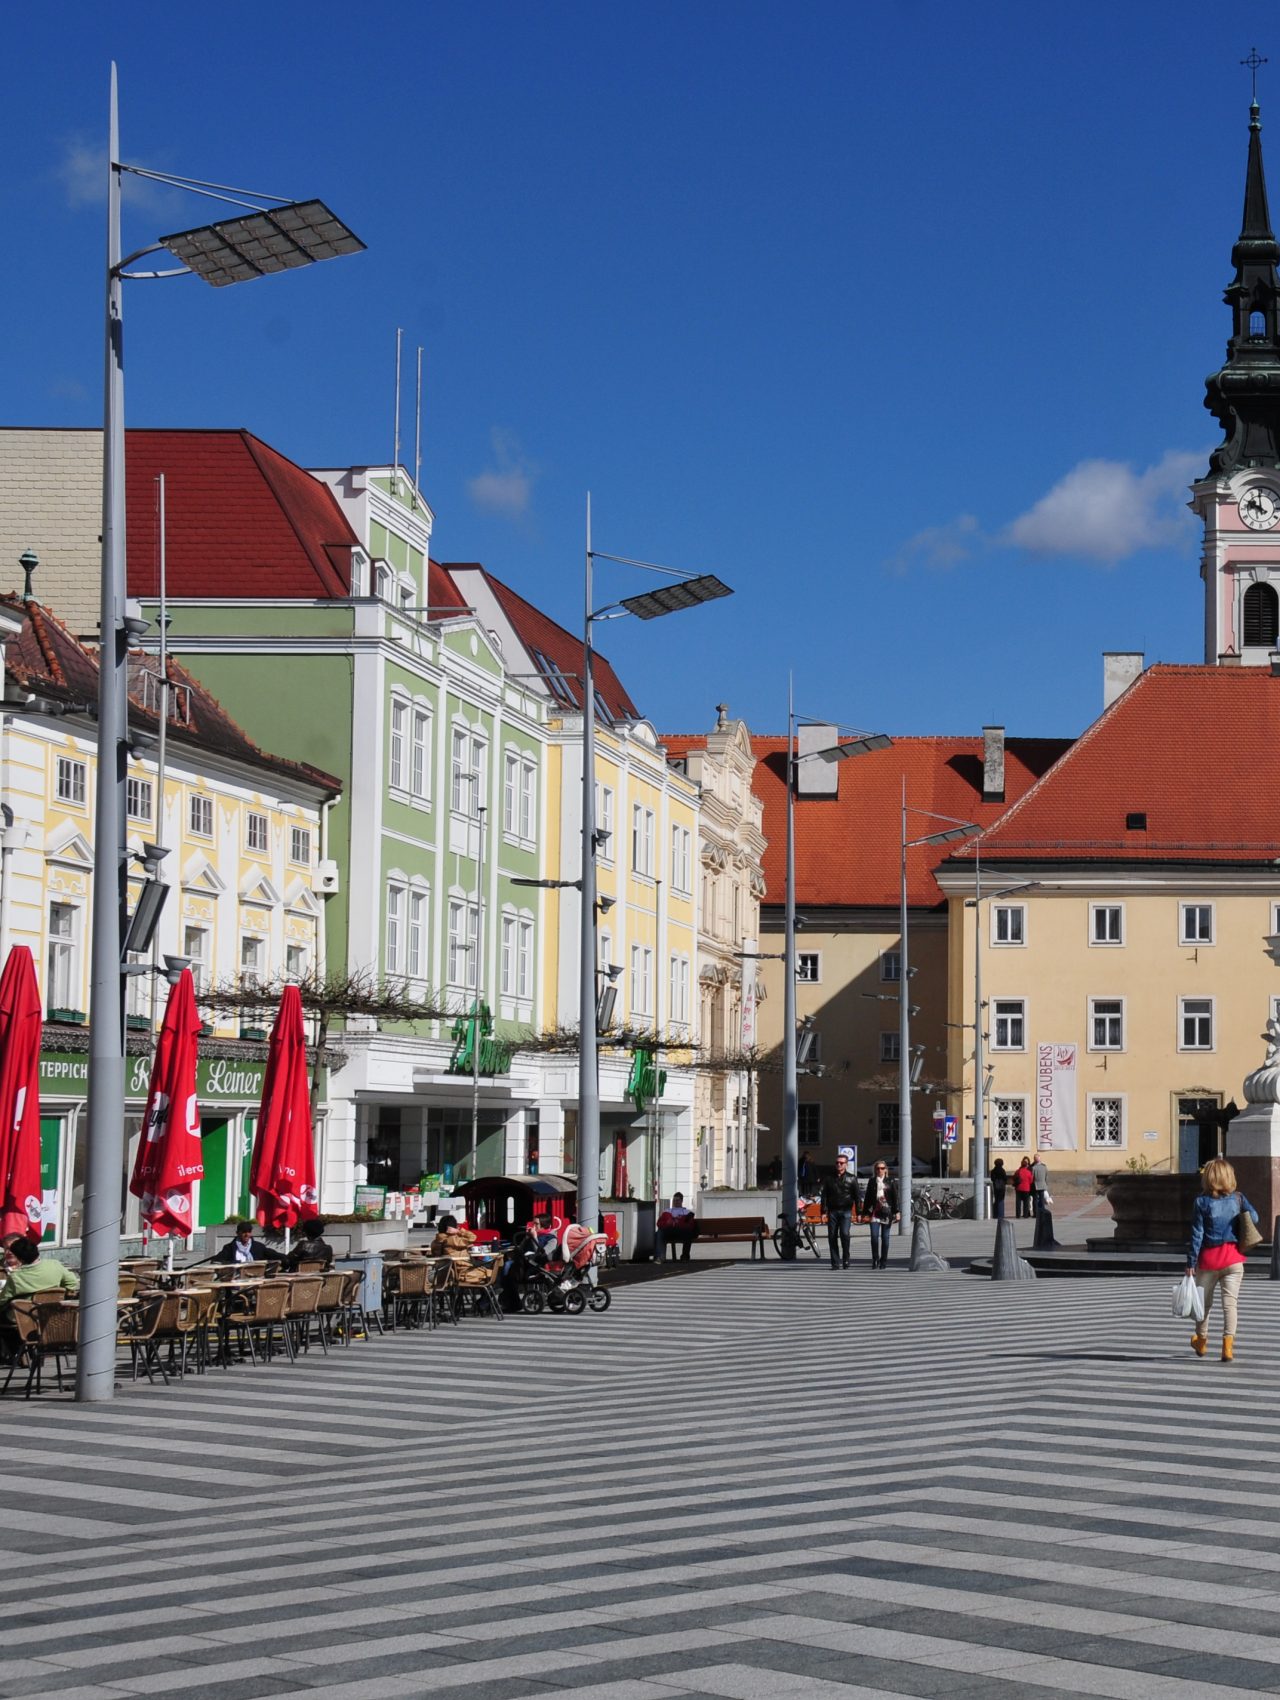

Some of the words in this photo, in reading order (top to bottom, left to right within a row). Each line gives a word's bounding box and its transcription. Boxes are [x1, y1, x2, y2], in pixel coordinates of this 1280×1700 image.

[206, 1059, 261, 1095] Leiner
[1039, 1045, 1053, 1109] GLAUBENS
[1039, 1116, 1053, 1147] JAHR
